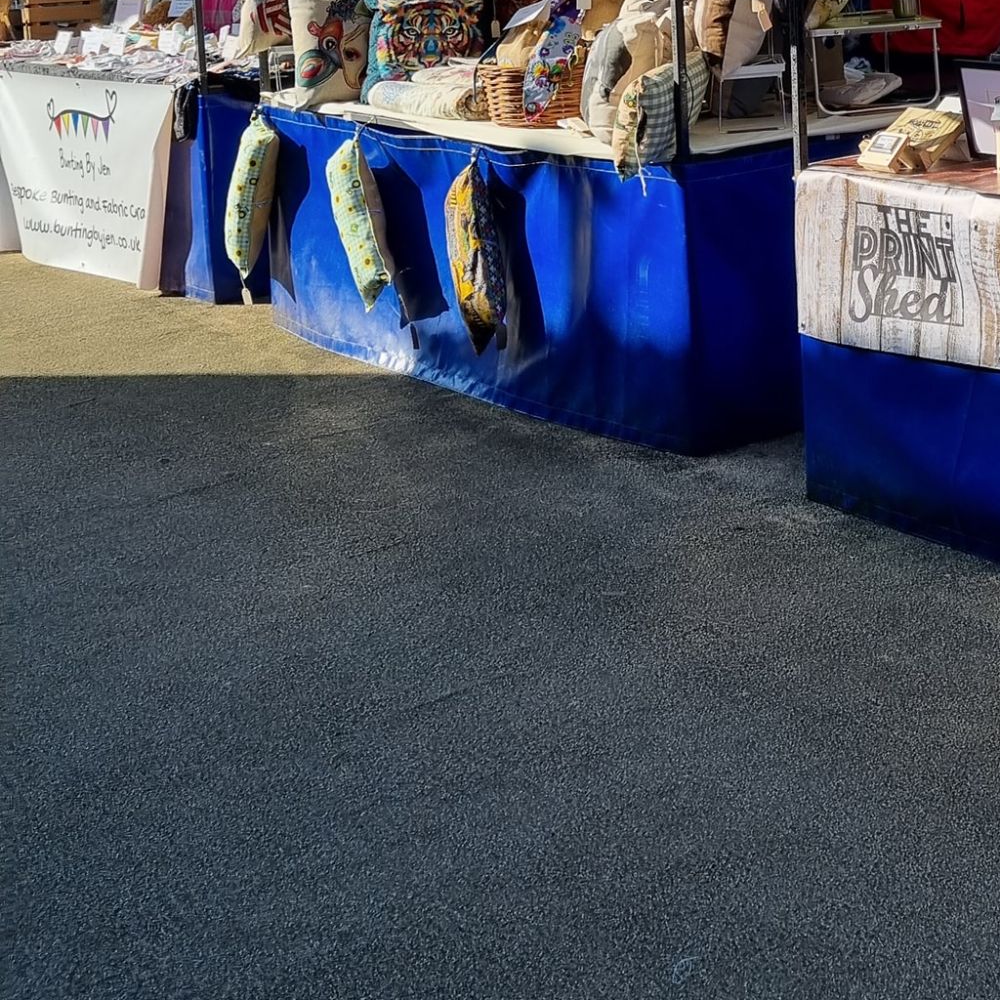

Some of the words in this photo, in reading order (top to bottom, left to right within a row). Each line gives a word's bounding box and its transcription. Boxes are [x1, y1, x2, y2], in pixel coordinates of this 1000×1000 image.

[59, 147, 85, 178] Bunting
[85, 152, 96, 181] By
[98, 156, 111, 176] Jen
[50, 190, 85, 214] Bunting
[85, 196, 101, 212] and
[102, 199, 129, 218] Fabric
[877, 205, 932, 237] THE
[852, 226, 957, 283] PRINT
[849, 263, 952, 322] Shed
